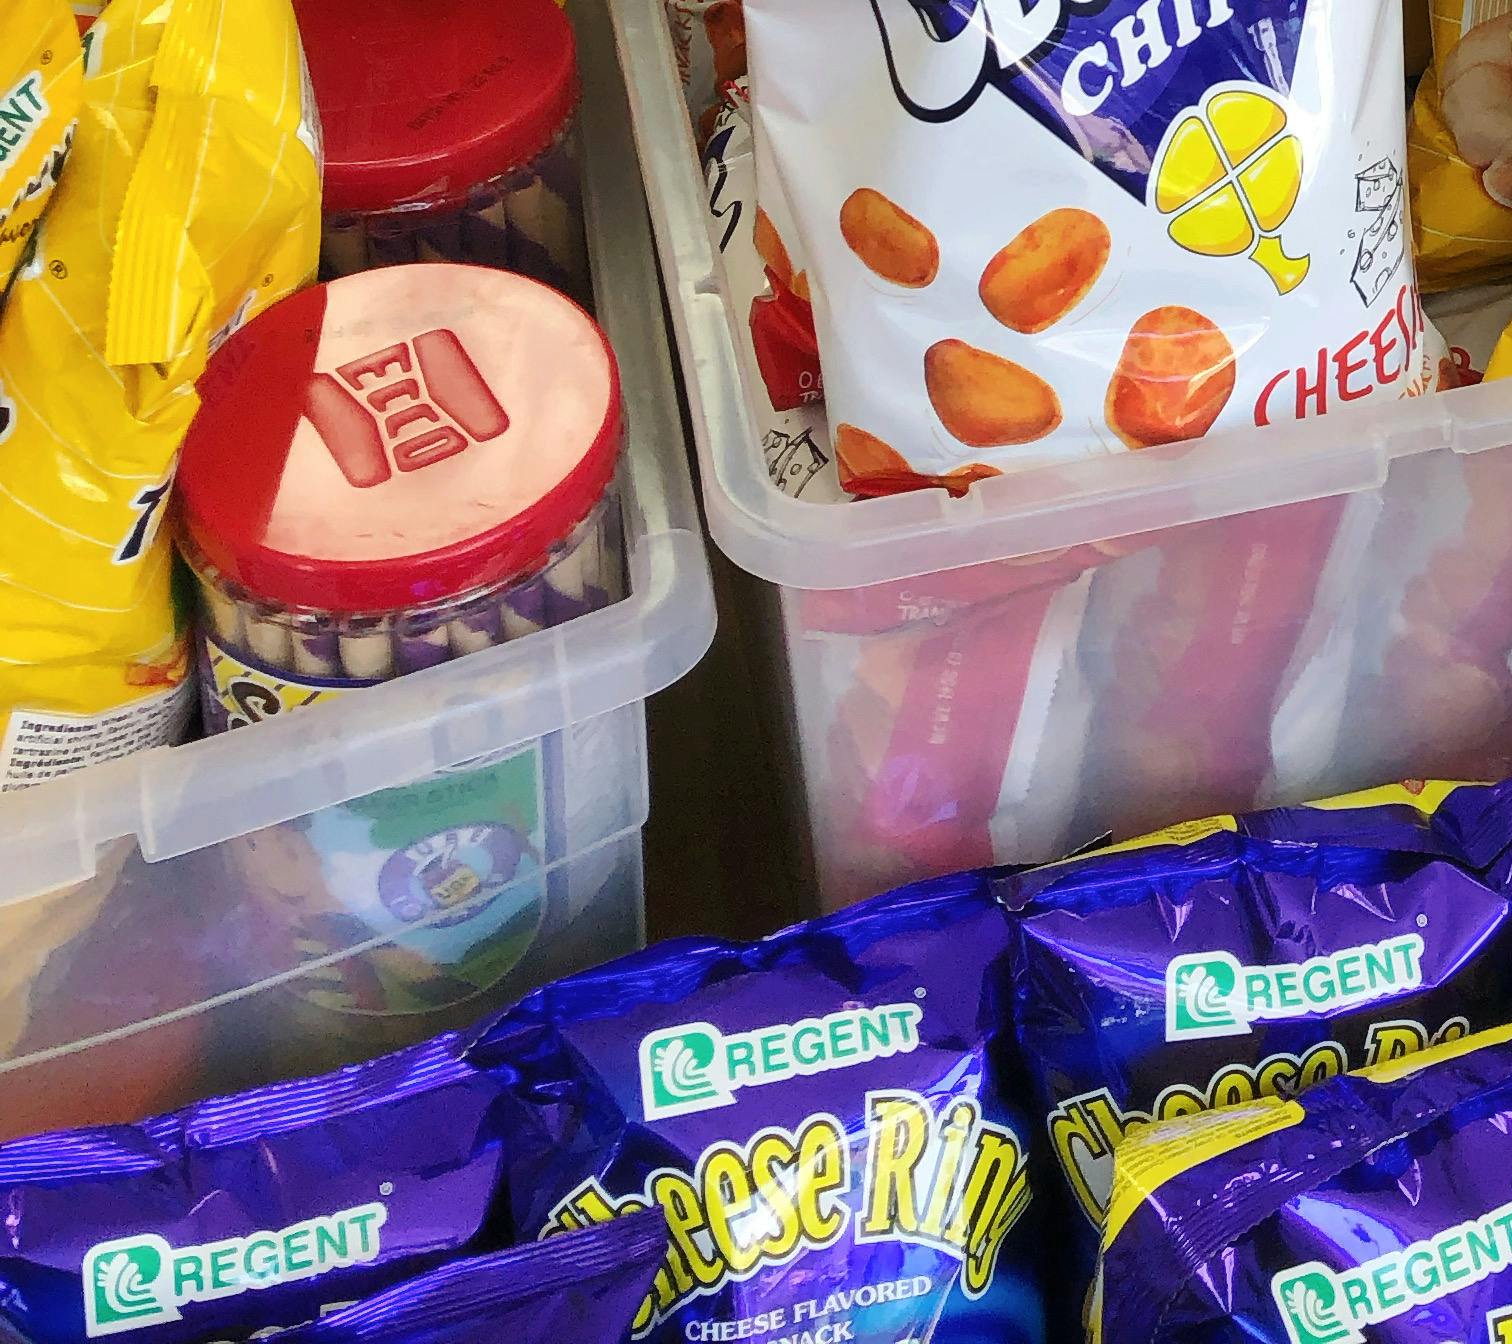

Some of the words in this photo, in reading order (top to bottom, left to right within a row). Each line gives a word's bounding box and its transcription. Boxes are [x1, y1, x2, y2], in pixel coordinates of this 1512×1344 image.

[1253, 284, 1425, 427] CHEES
[1247, 942, 1421, 1013] REGENT
[723, 1007, 918, 1084] REGENT
[171, 1211, 382, 1300] REGENT
[685, 1305, 786, 1344] CHEESE
[793, 1274, 933, 1328] FLAVORED
